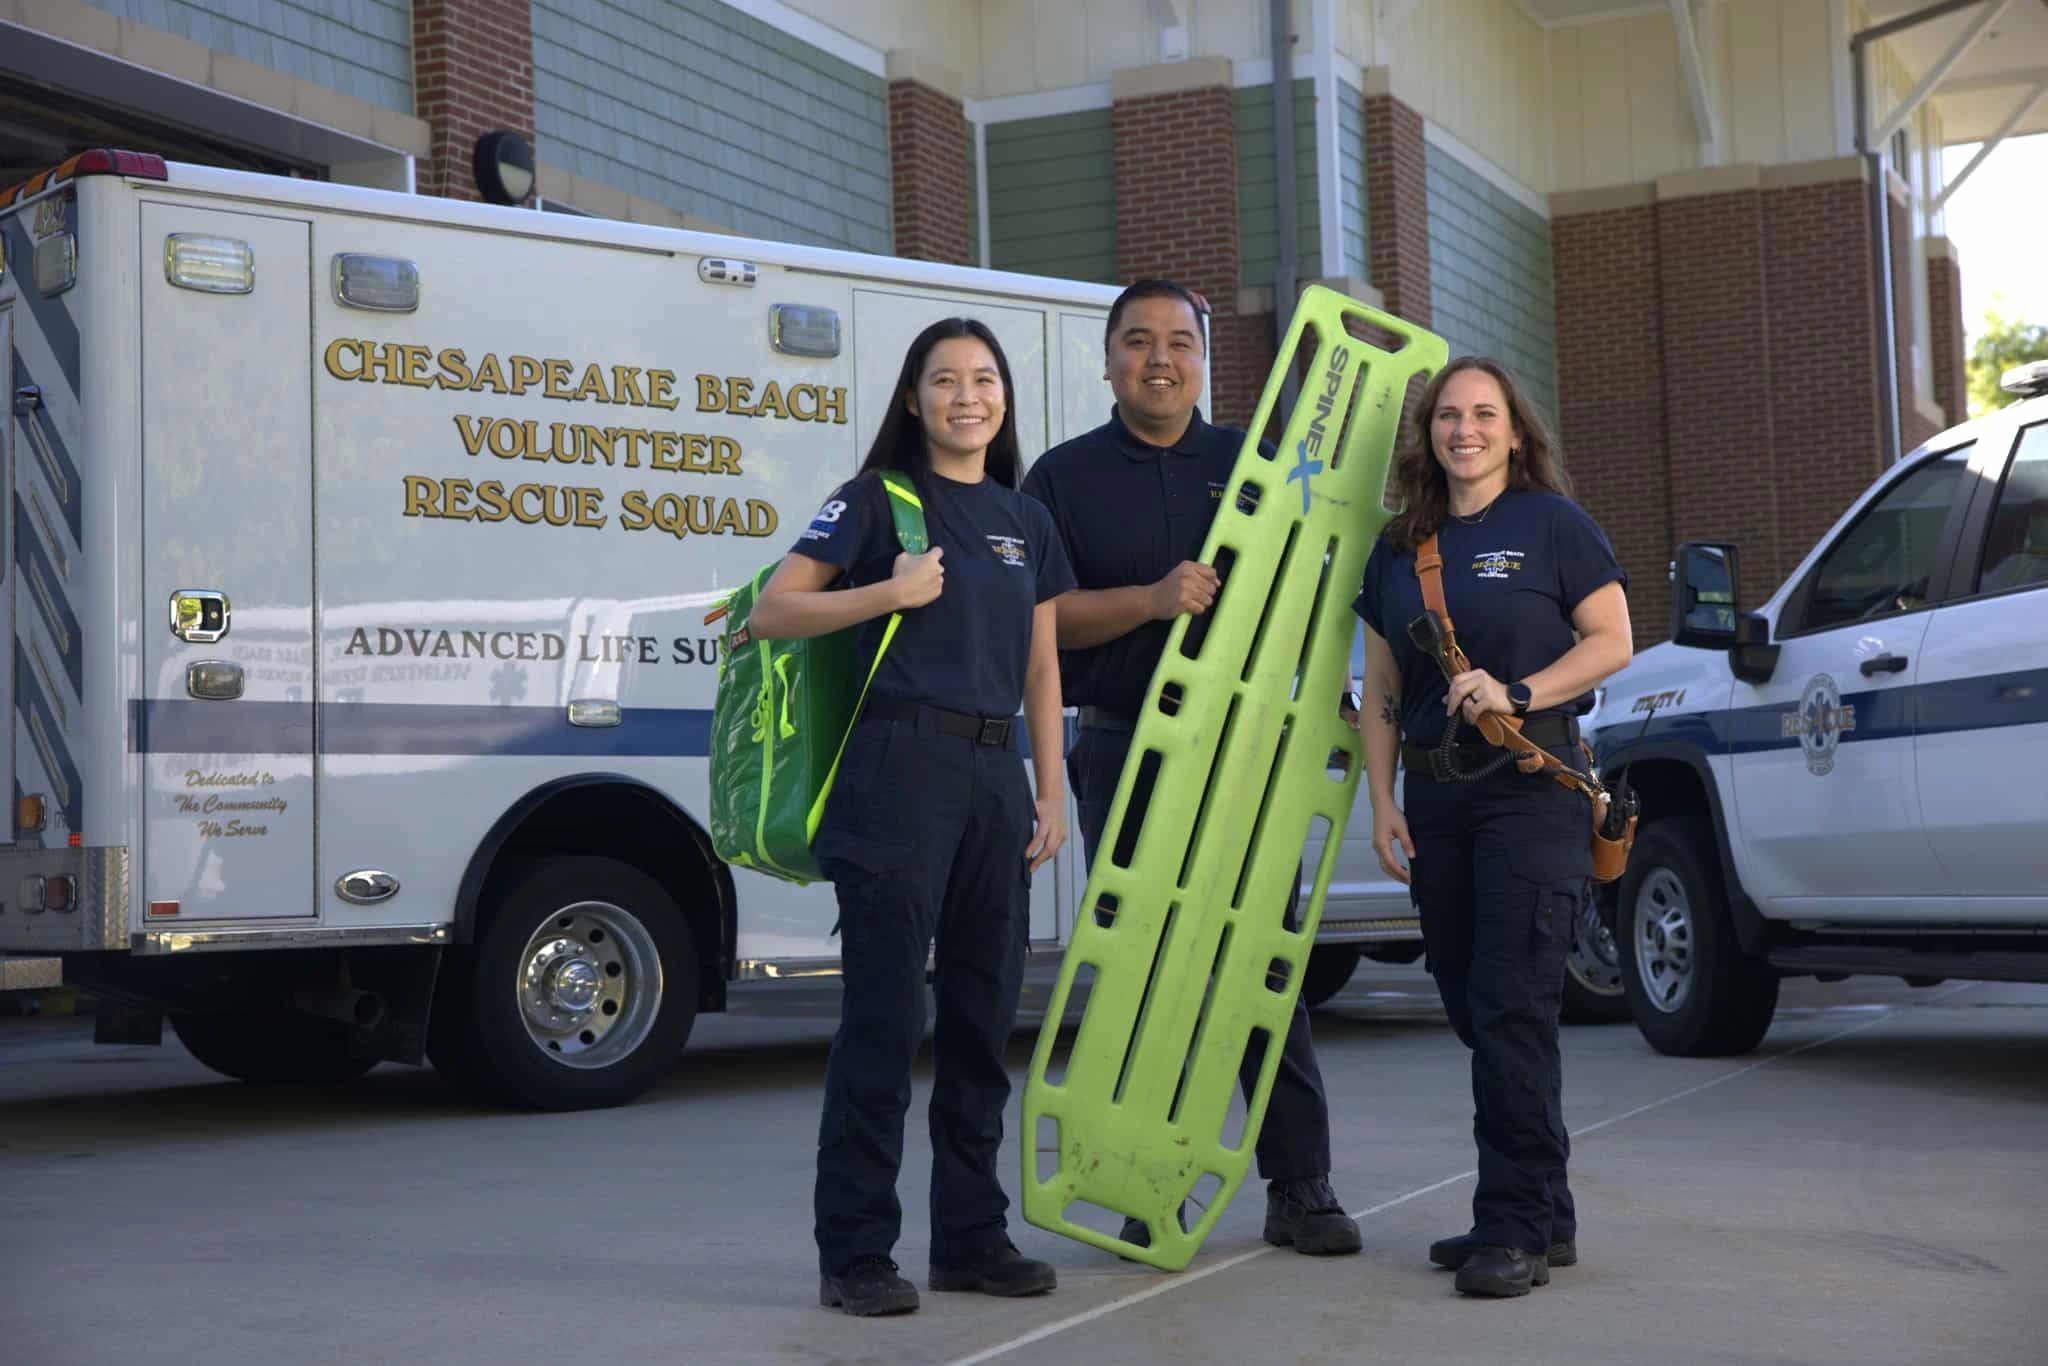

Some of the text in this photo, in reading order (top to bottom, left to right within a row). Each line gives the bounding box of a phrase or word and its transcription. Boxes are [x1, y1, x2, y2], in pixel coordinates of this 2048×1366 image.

[324, 338, 848, 424] CHESAPEAKE BEACH
[454, 415, 743, 475] VOLUNTEER
[402, 475, 778, 540] RESCUE SQUAD
[344, 626, 565, 661] ADVANCED
[578, 634, 661, 664] LIFE
[184, 769, 275, 787] Dedicated to
[174, 794, 288, 816] The Community
[197, 819, 269, 837] We Serve
